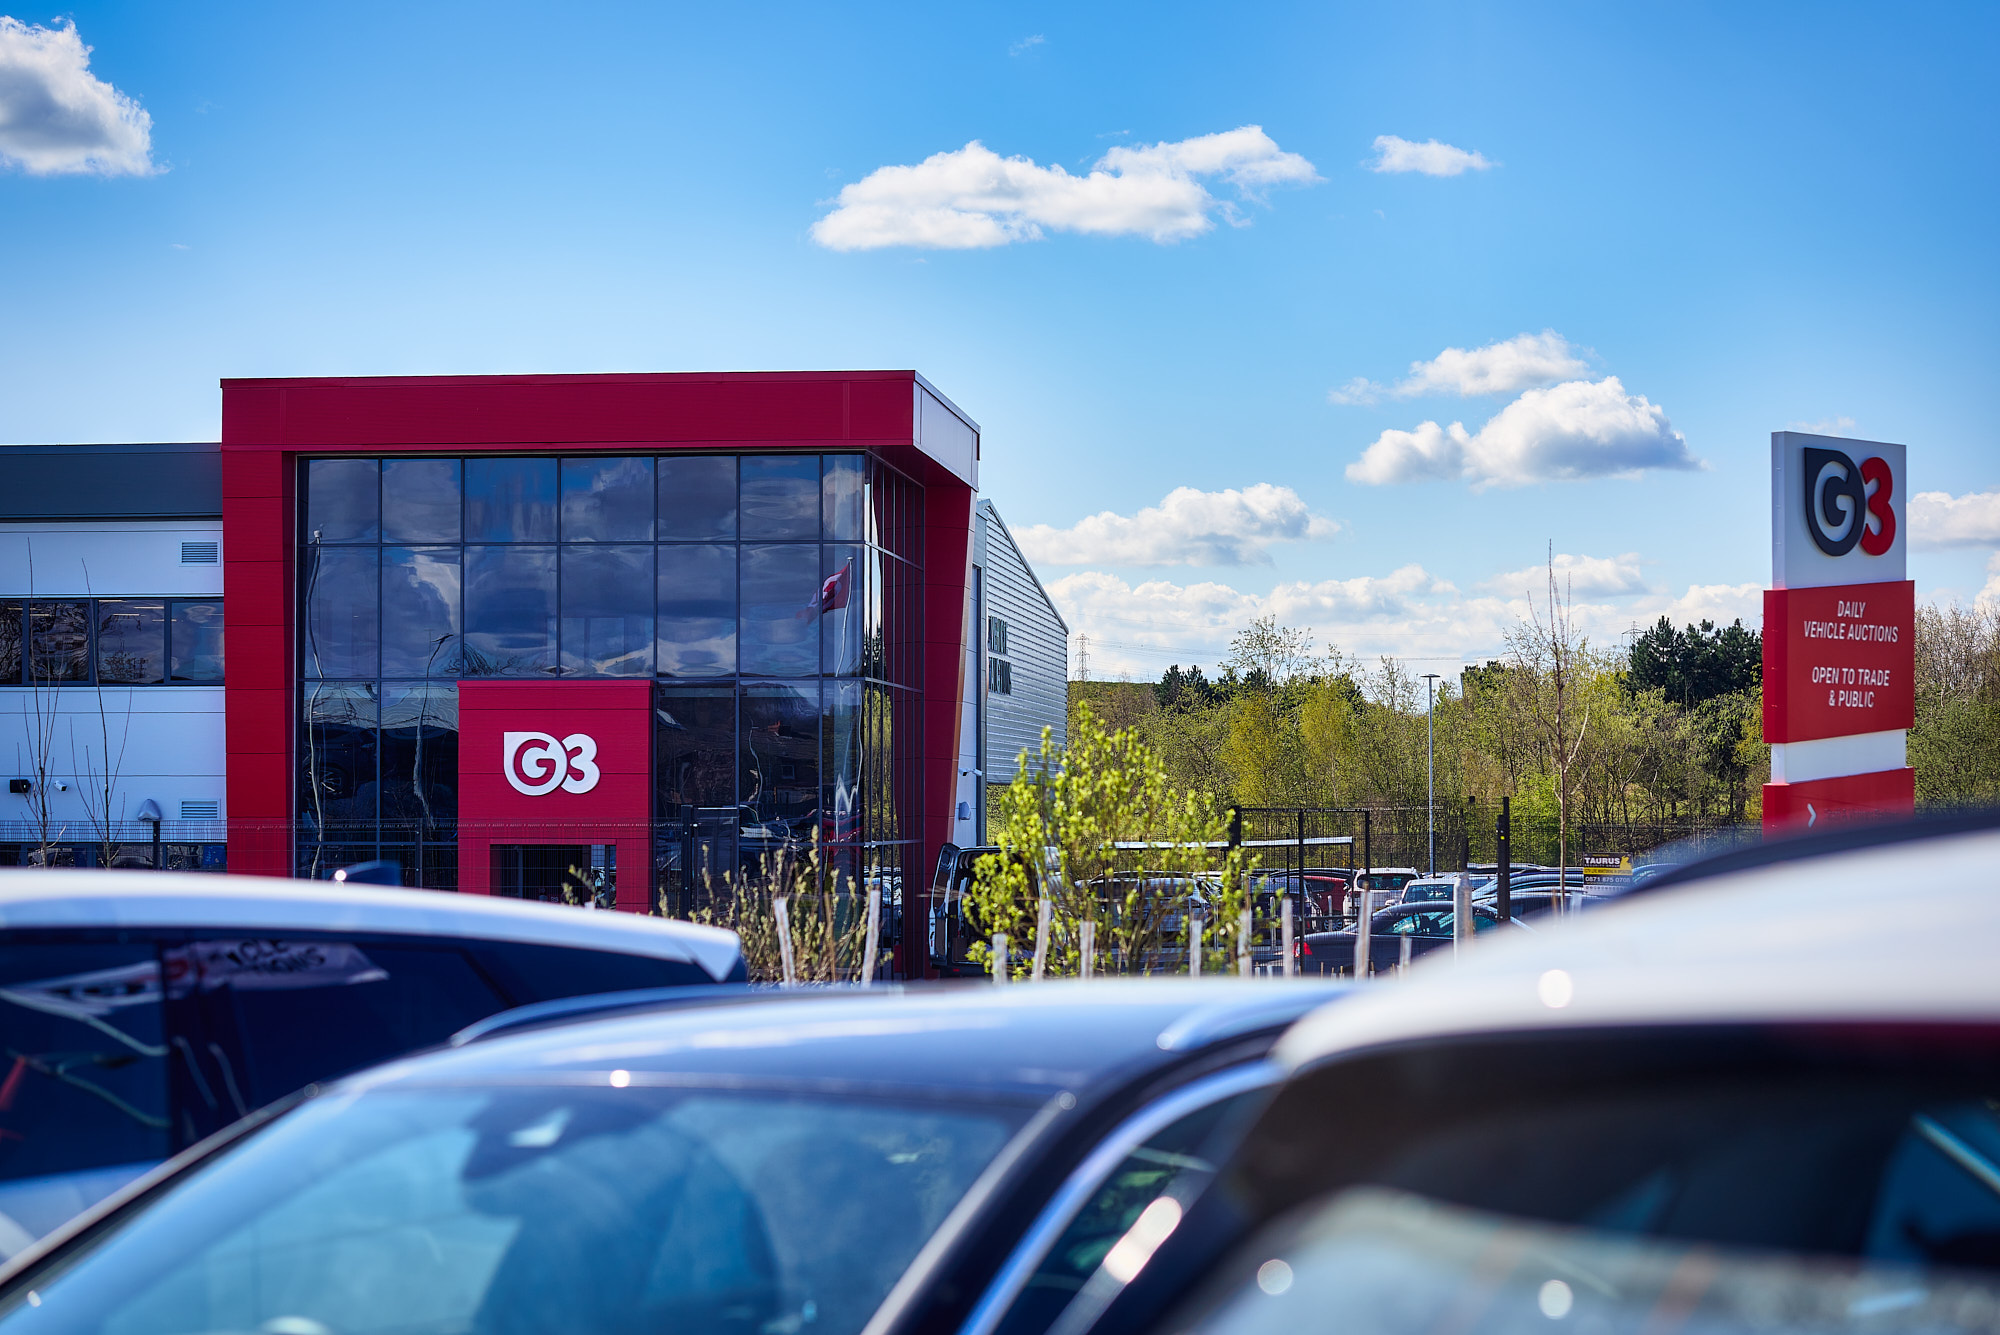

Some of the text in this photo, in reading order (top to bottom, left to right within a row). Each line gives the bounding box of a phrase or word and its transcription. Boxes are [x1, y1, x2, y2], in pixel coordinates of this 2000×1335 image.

[1804, 447, 1896, 556] G3
[1837, 600, 1866, 618] DAILY
[1804, 620, 1899, 642] VEHICLE AUCTIONS
[1812, 666, 1890, 686] OPEN TO TRADE
[1828, 690, 1875, 708] & PUBLIC
[503, 731, 601, 796] G3
[1584, 857, 1620, 865] TAURUS
